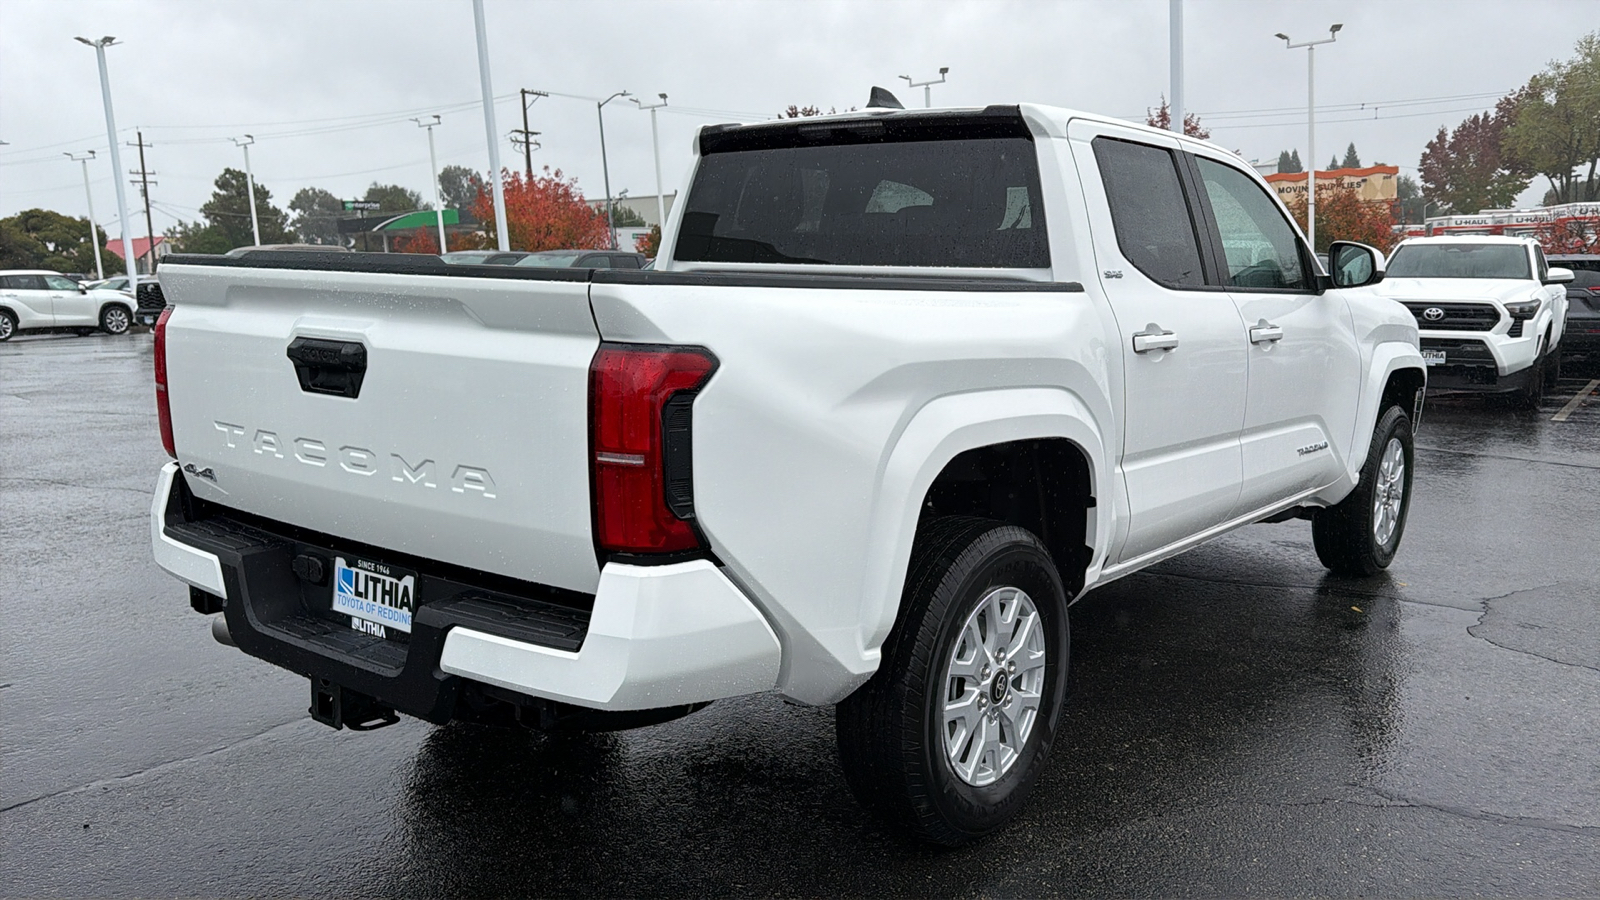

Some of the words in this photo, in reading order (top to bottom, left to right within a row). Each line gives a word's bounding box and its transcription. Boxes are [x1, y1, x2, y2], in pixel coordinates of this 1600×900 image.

[1278, 185, 1309, 194] MOVIN
[213, 420, 497, 499] TACOMA
[357, 559, 375, 571] SINCE
[376, 564, 390, 575] 1946
[354, 571, 413, 612] LITHIA
[337, 594, 364, 611] TOYOTA
[365, 602, 377, 615] OF
[377, 605, 412, 626] REDDING
[359, 618, 386, 639] LITHIA
